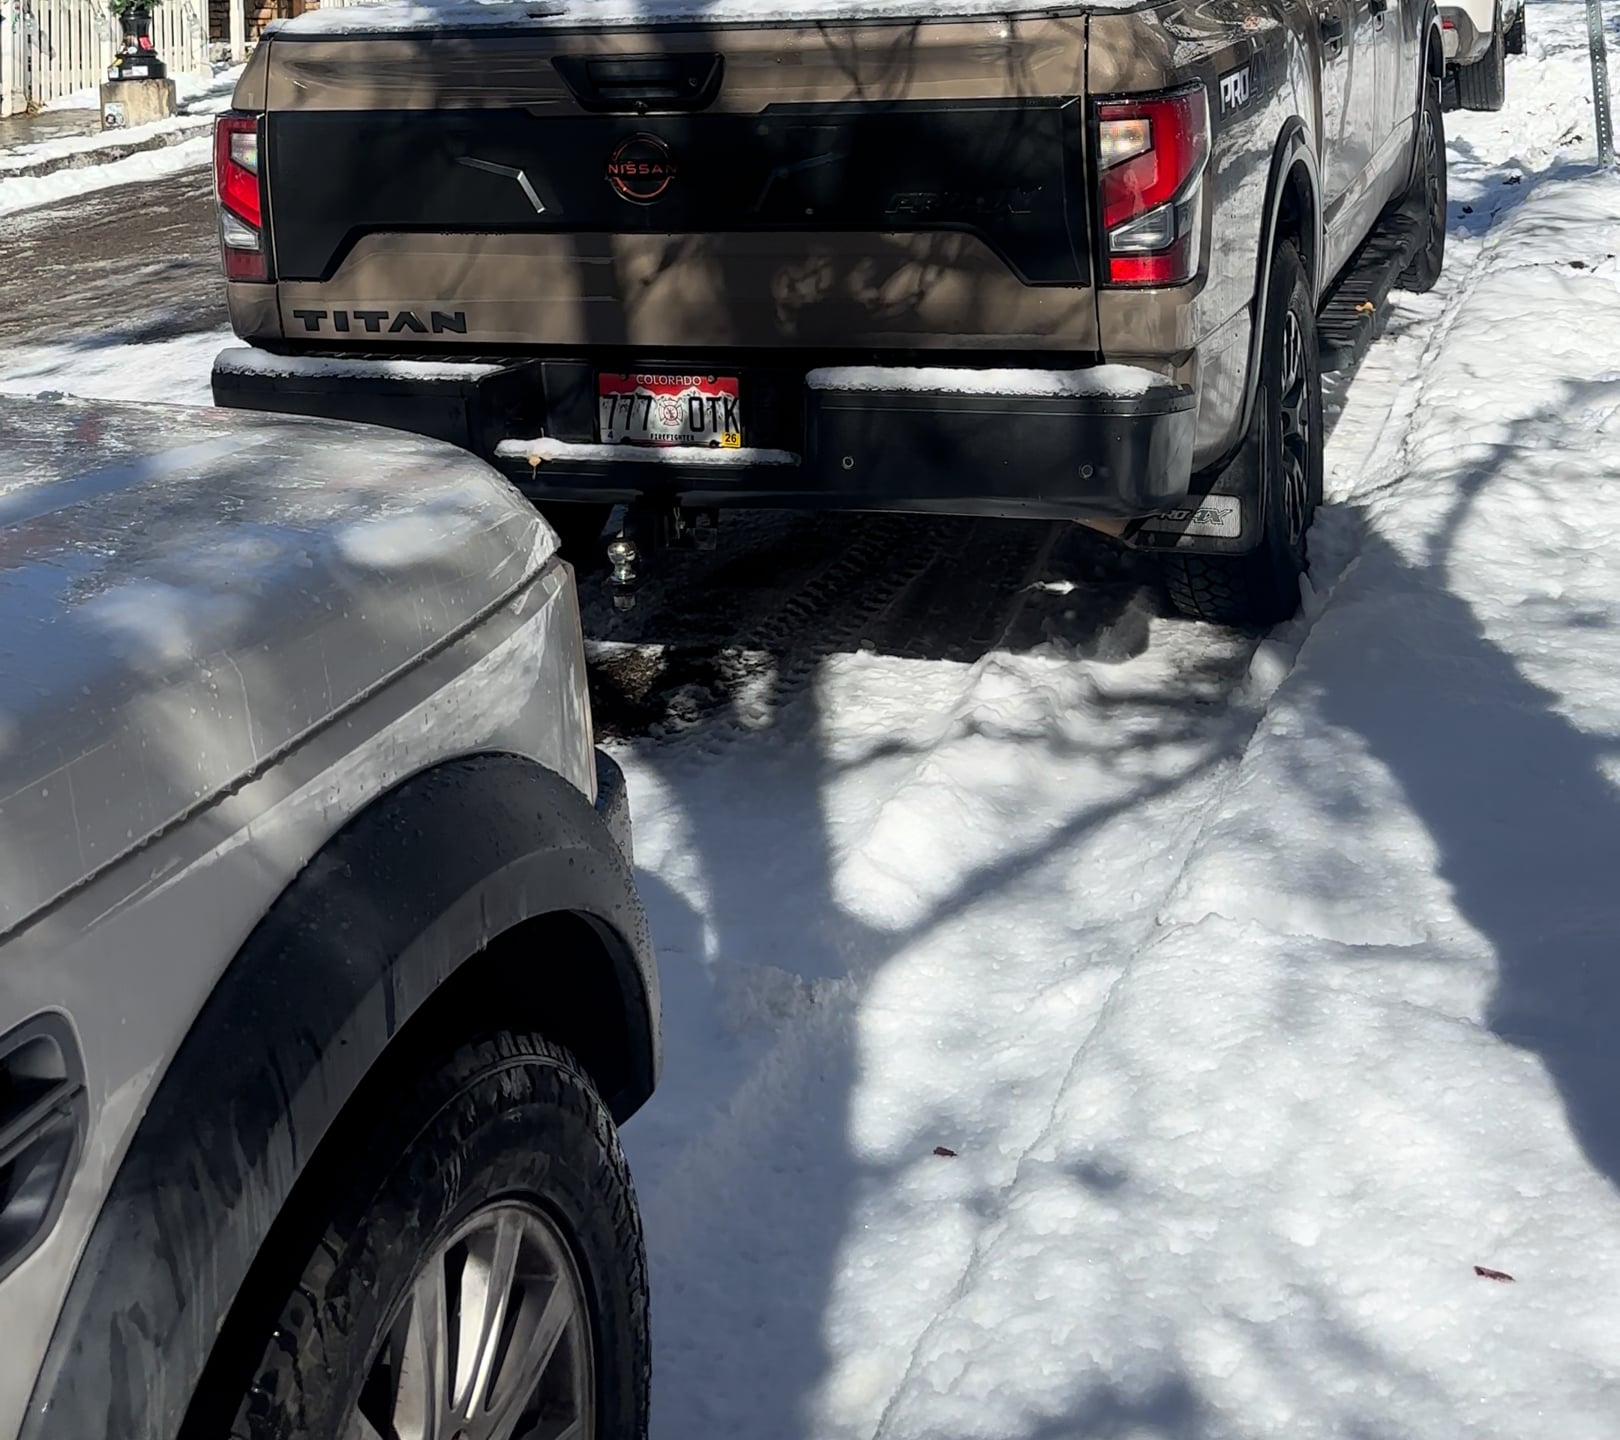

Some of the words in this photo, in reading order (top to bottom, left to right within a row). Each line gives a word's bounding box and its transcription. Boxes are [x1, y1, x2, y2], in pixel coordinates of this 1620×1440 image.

[608, 163, 677, 175] NISSAN
[293, 310, 468, 334] TITAN
[636, 374, 702, 386] COLORADO
[600, 394, 653, 431] 777
[725, 433, 737, 443] 26
